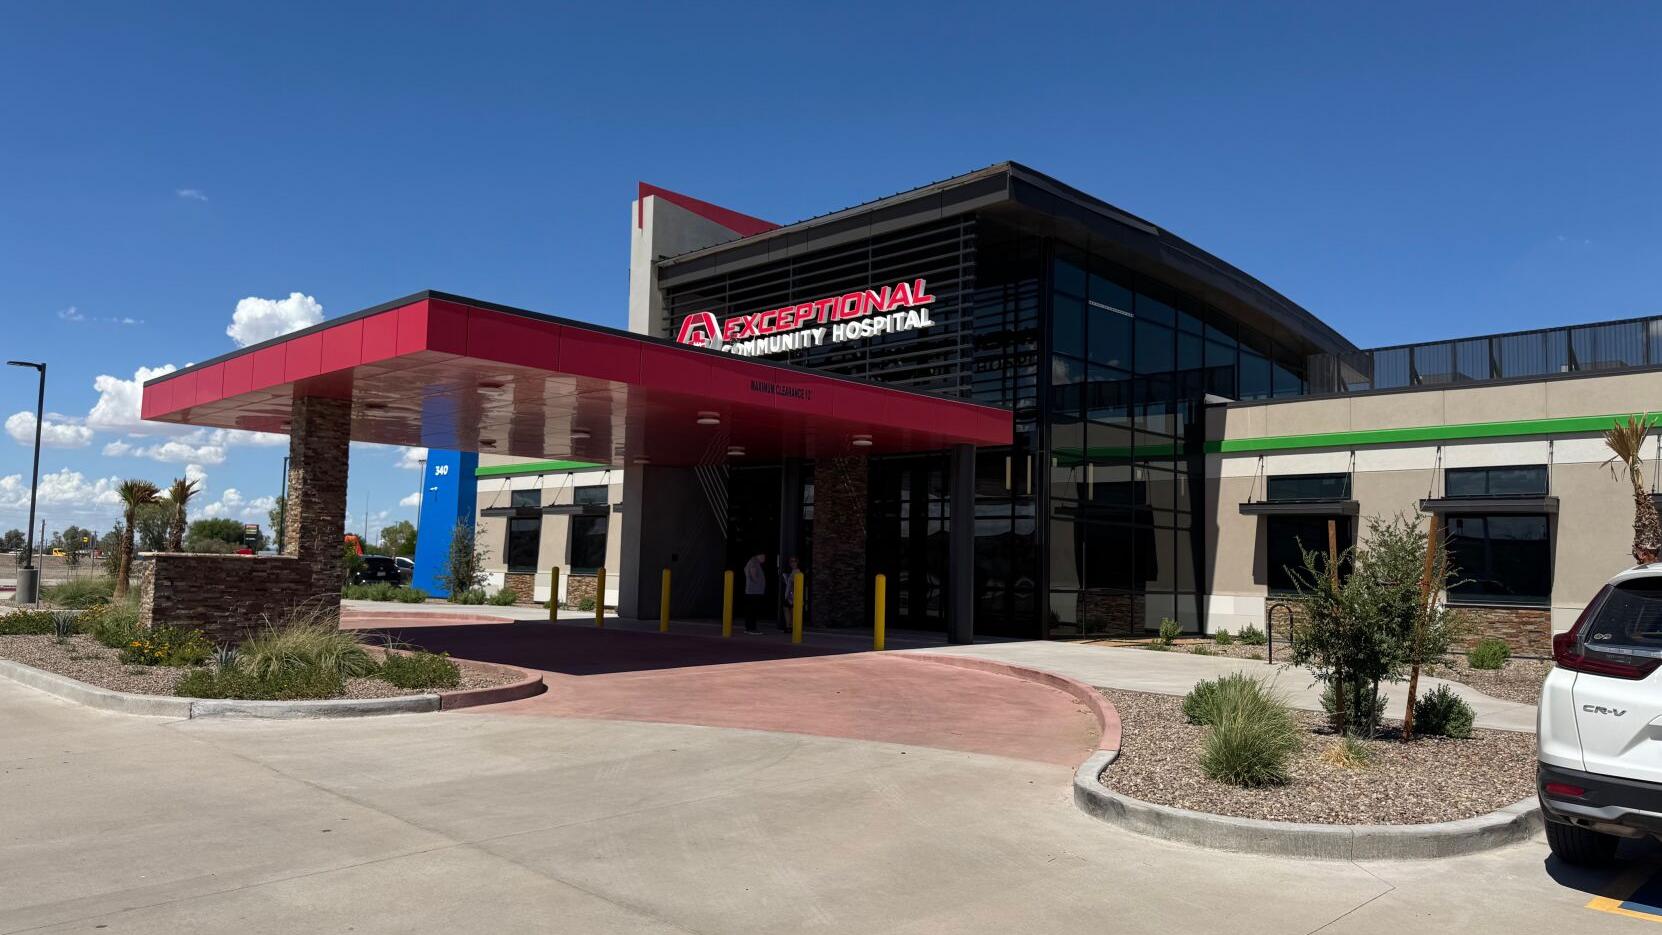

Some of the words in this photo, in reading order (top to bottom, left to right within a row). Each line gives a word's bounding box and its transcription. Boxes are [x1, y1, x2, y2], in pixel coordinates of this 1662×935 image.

[722, 279, 935, 341] EXCEPTIONAL
[832, 308, 934, 343] HOSPITAL
[751, 379, 775, 393] MAXIMUM
[776, 384, 805, 399] CLEARANCE
[434, 465, 449, 476] 340
[1582, 704, 1627, 717] CR-V
